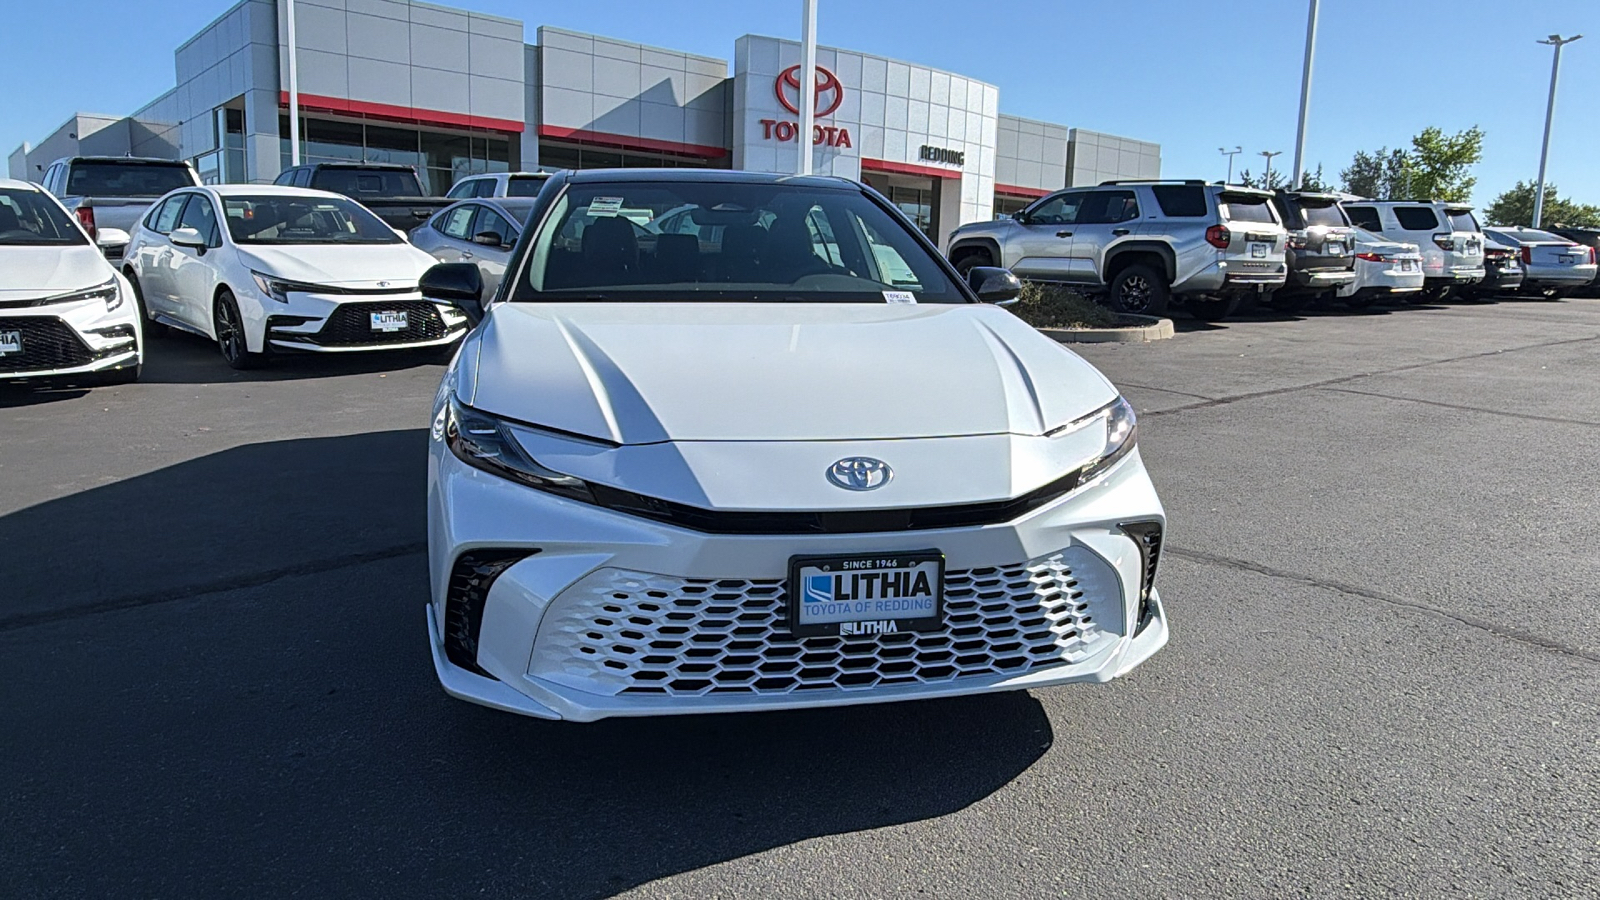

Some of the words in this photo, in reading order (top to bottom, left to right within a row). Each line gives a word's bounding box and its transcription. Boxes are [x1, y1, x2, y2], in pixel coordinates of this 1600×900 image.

[920, 145, 964, 165] REDDING
[381, 315, 406, 323] LITHIA
[843, 561, 872, 569] SINCE
[875, 559, 897, 567] 1946
[834, 571, 932, 600] LITHIA
[804, 602, 850, 616] TOYOTA
[855, 601, 871, 612] OF
[875, 599, 932, 611] REDDING
[853, 620, 897, 634] LITHIA
